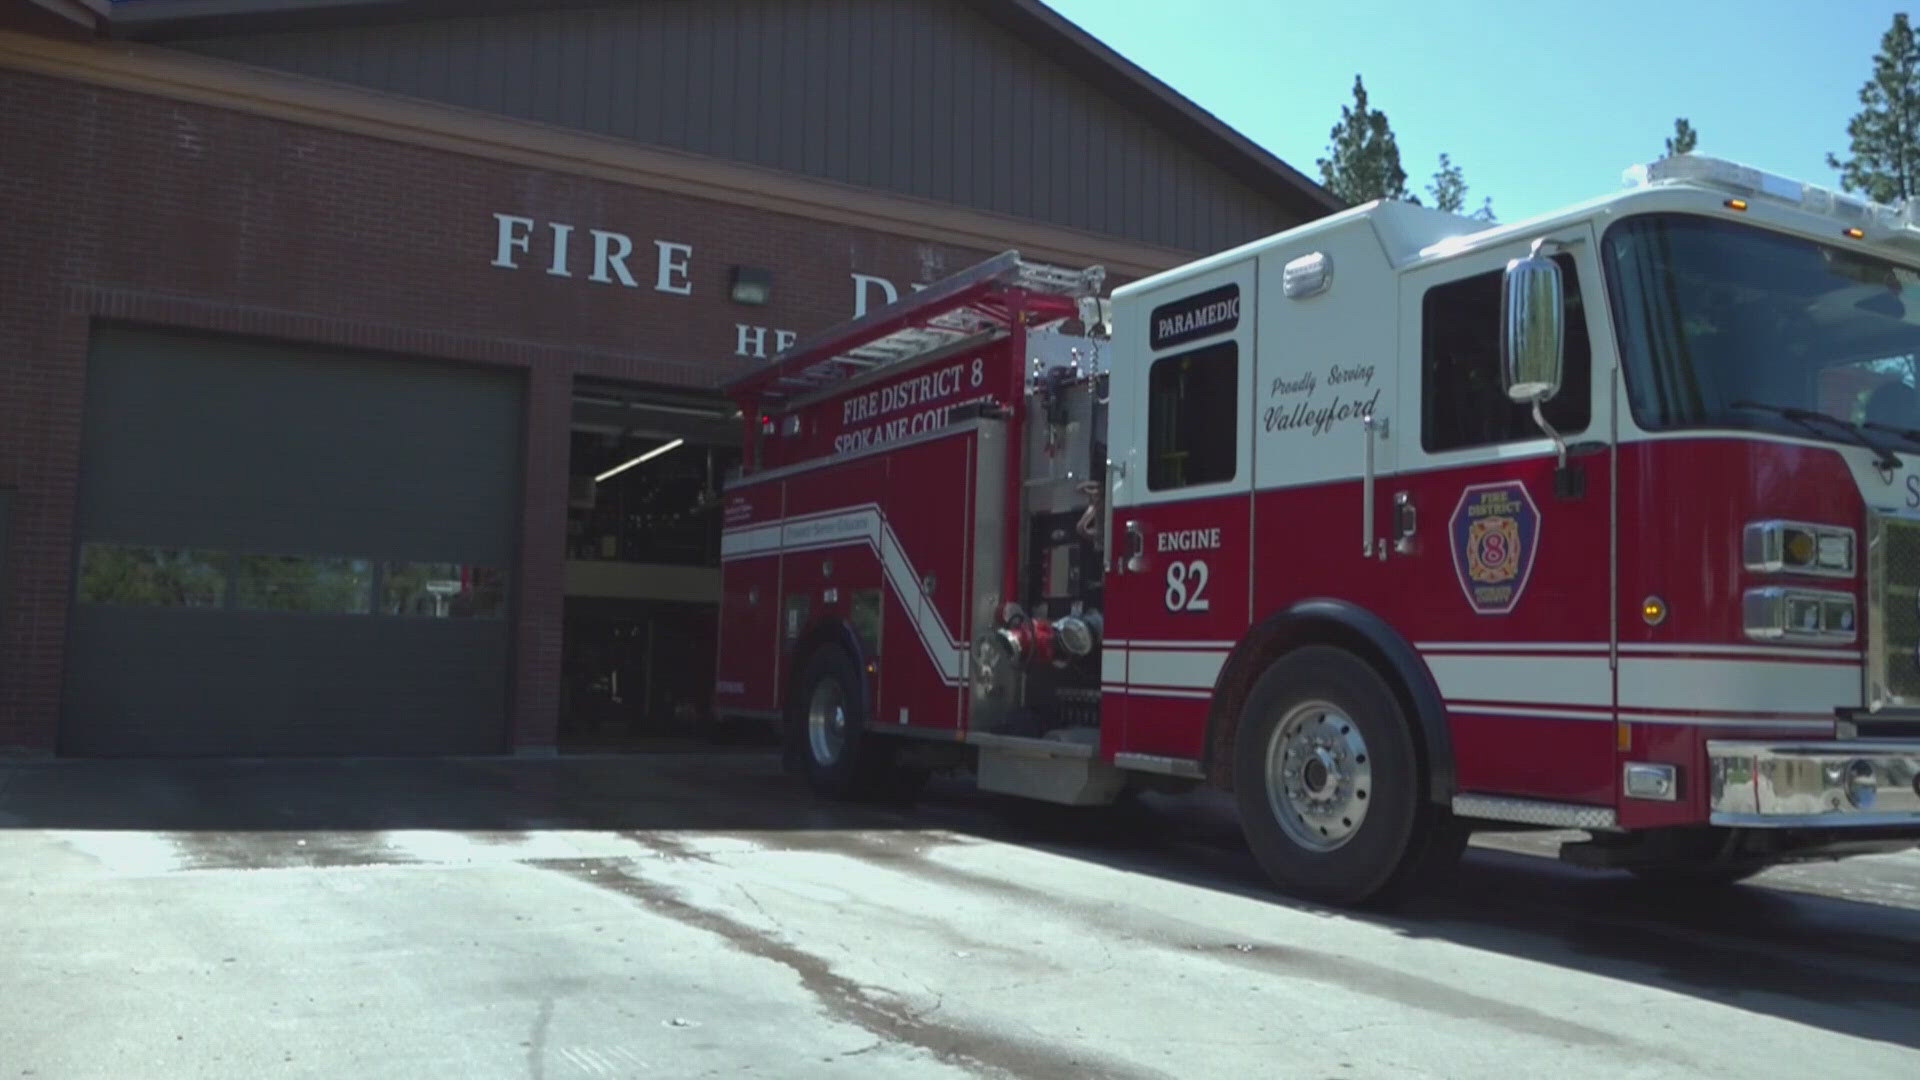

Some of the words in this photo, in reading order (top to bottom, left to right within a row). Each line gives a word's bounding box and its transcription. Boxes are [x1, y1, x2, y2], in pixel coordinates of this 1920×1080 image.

[491, 212, 694, 296] FIRE
[1158, 296, 1240, 339] PARAMEDIC
[842, 391, 877, 425] FIRE
[881, 364, 964, 413] DISTRICT
[970, 358, 984, 387] 8
[1271, 370, 1317, 398] Proudly
[1328, 362, 1375, 387] Serving
[1264, 388, 1381, 437] Valleyford
[834, 417, 908, 455] SPOKANE
[1468, 500, 1522, 517] DISTRICT
[1157, 528, 1221, 551] ENGINE
[1481, 530, 1506, 566] 8
[1165, 560, 1209, 611] 82
